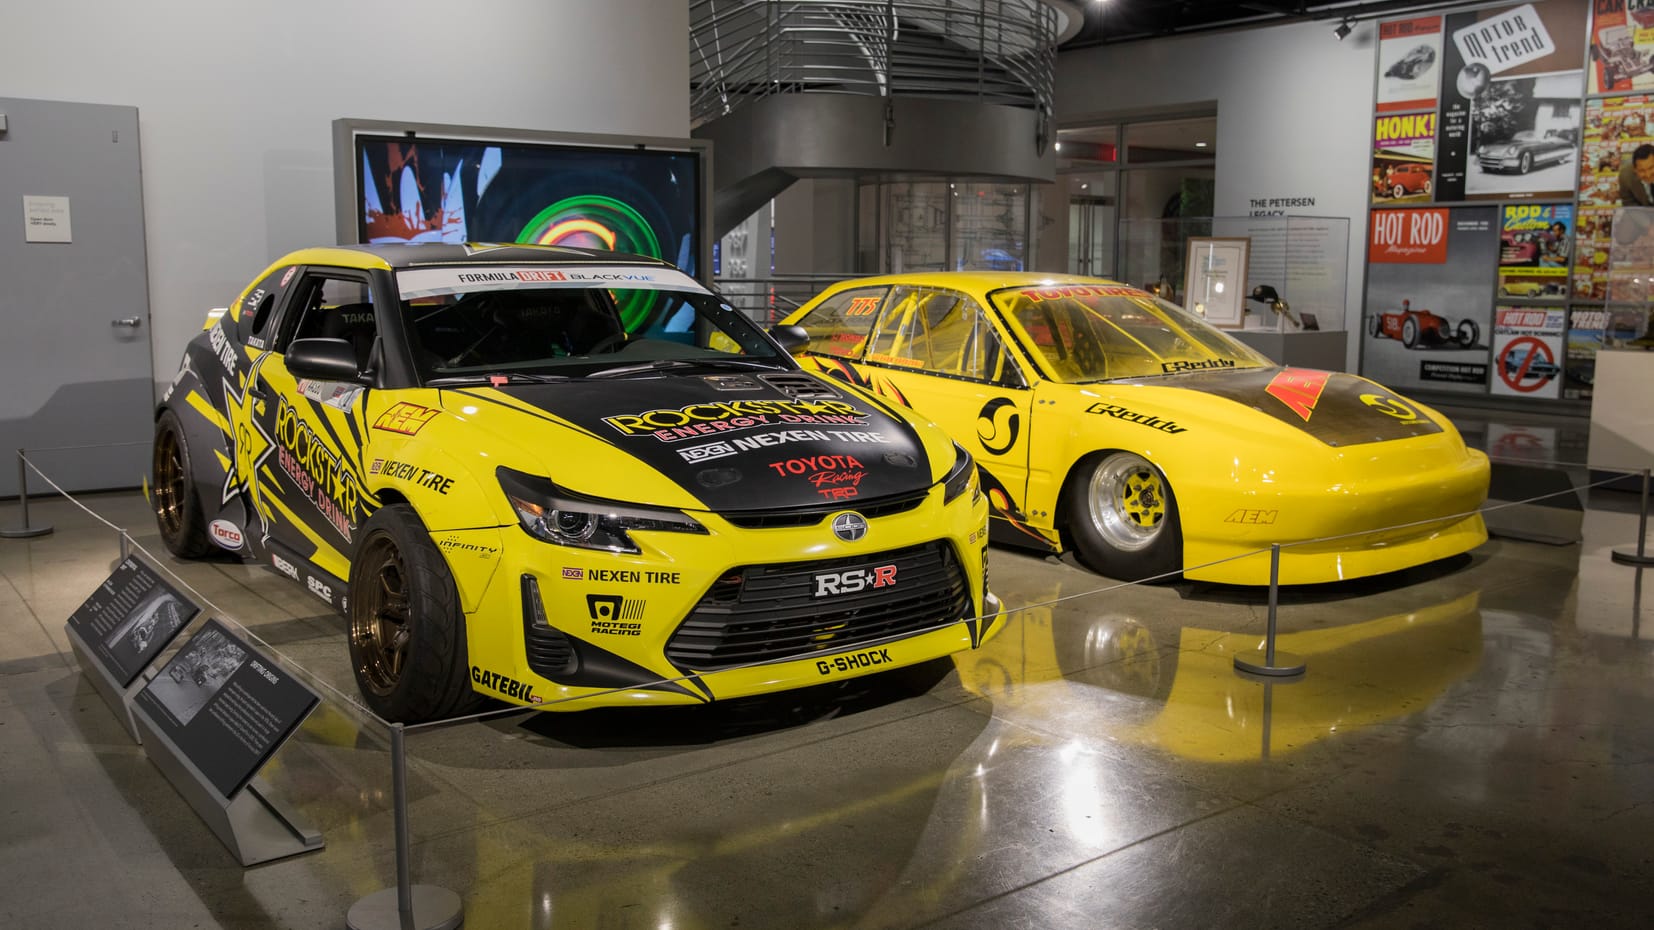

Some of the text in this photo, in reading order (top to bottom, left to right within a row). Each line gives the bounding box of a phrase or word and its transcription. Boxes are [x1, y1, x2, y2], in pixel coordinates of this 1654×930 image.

[1376, 113, 1436, 141] HONK!
[1250, 197, 1315, 208] THE PETERSEN
[1505, 205, 1542, 218] ROD
[1374, 212, 1443, 245] HOT ROD
[458, 272, 518, 283] FORMULA
[519, 271, 566, 281] DRIFT
[847, 298, 881, 315] 775
[342, 314, 374, 323] TAKA
[220, 340, 238, 376] TIRE
[1161, 358, 1235, 373] GReddy
[606, 400, 866, 435] ROCKSTAR
[654, 413, 863, 441] ENERGY DRINK
[1085, 402, 1188, 434] GReddy
[739, 430, 826, 451] NEXEN
[832, 430, 890, 443] TIRE
[769, 455, 864, 478] TOYOTA
[380, 460, 420, 481] NEXEN
[416, 470, 455, 495] TIRE
[808, 471, 868, 487] Racing
[279, 445, 350, 538] ENERGY DRINK
[818, 487, 857, 499] TRD
[1224, 509, 1278, 524] AEM
[213, 523, 241, 542] Torco
[307, 575, 332, 598] SPC
[588, 569, 640, 583] NEXEN
[645, 571, 681, 584] TIRE
[591, 621, 641, 629] MOTEGI
[591, 628, 641, 636] RACING
[816, 649, 892, 675] G-SHOCK
[471, 665, 533, 703] GATEBIL
